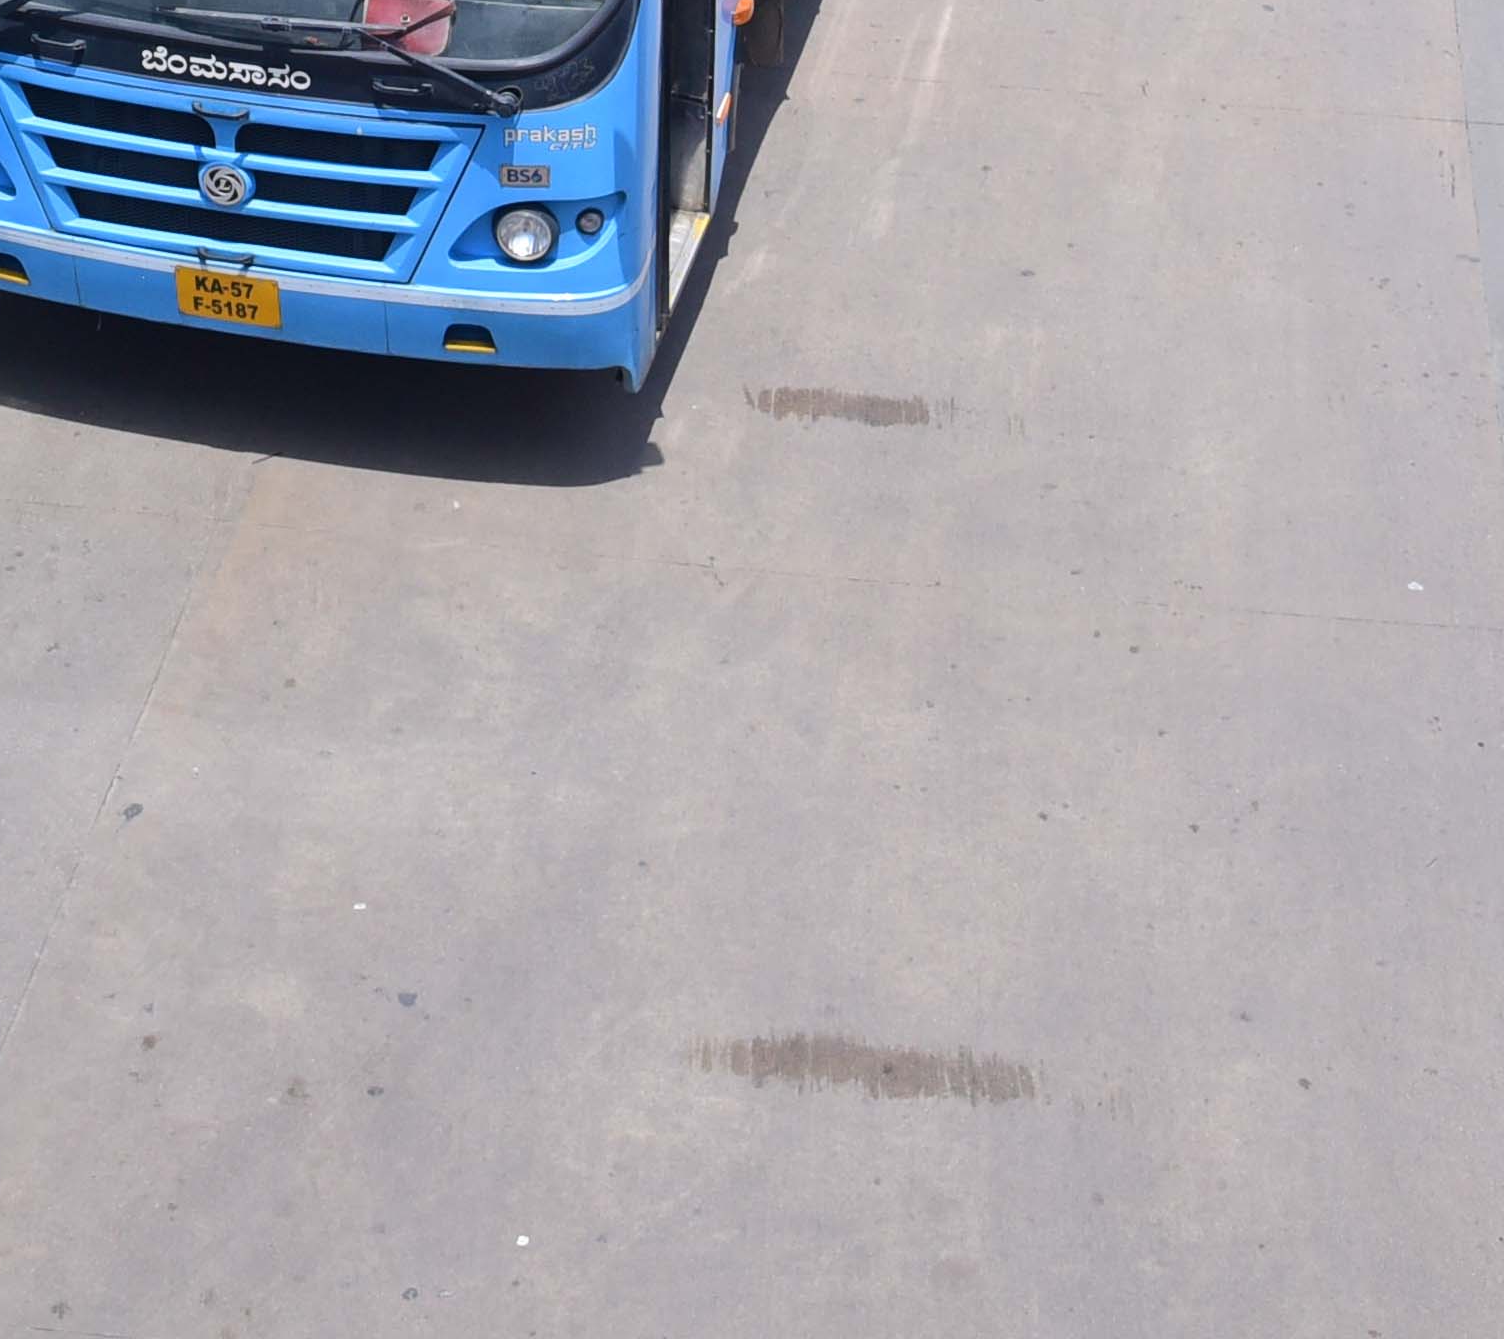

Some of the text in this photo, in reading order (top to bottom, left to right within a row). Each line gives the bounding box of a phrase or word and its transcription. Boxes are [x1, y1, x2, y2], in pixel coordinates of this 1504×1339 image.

[141, 44, 312, 92] ಬೆಂಮಸಾಸಂ
[503, 122, 598, 147] prakash
[506, 168, 543, 184] BS6
[194, 274, 254, 300] KA-57
[192, 297, 260, 321] F-5187
